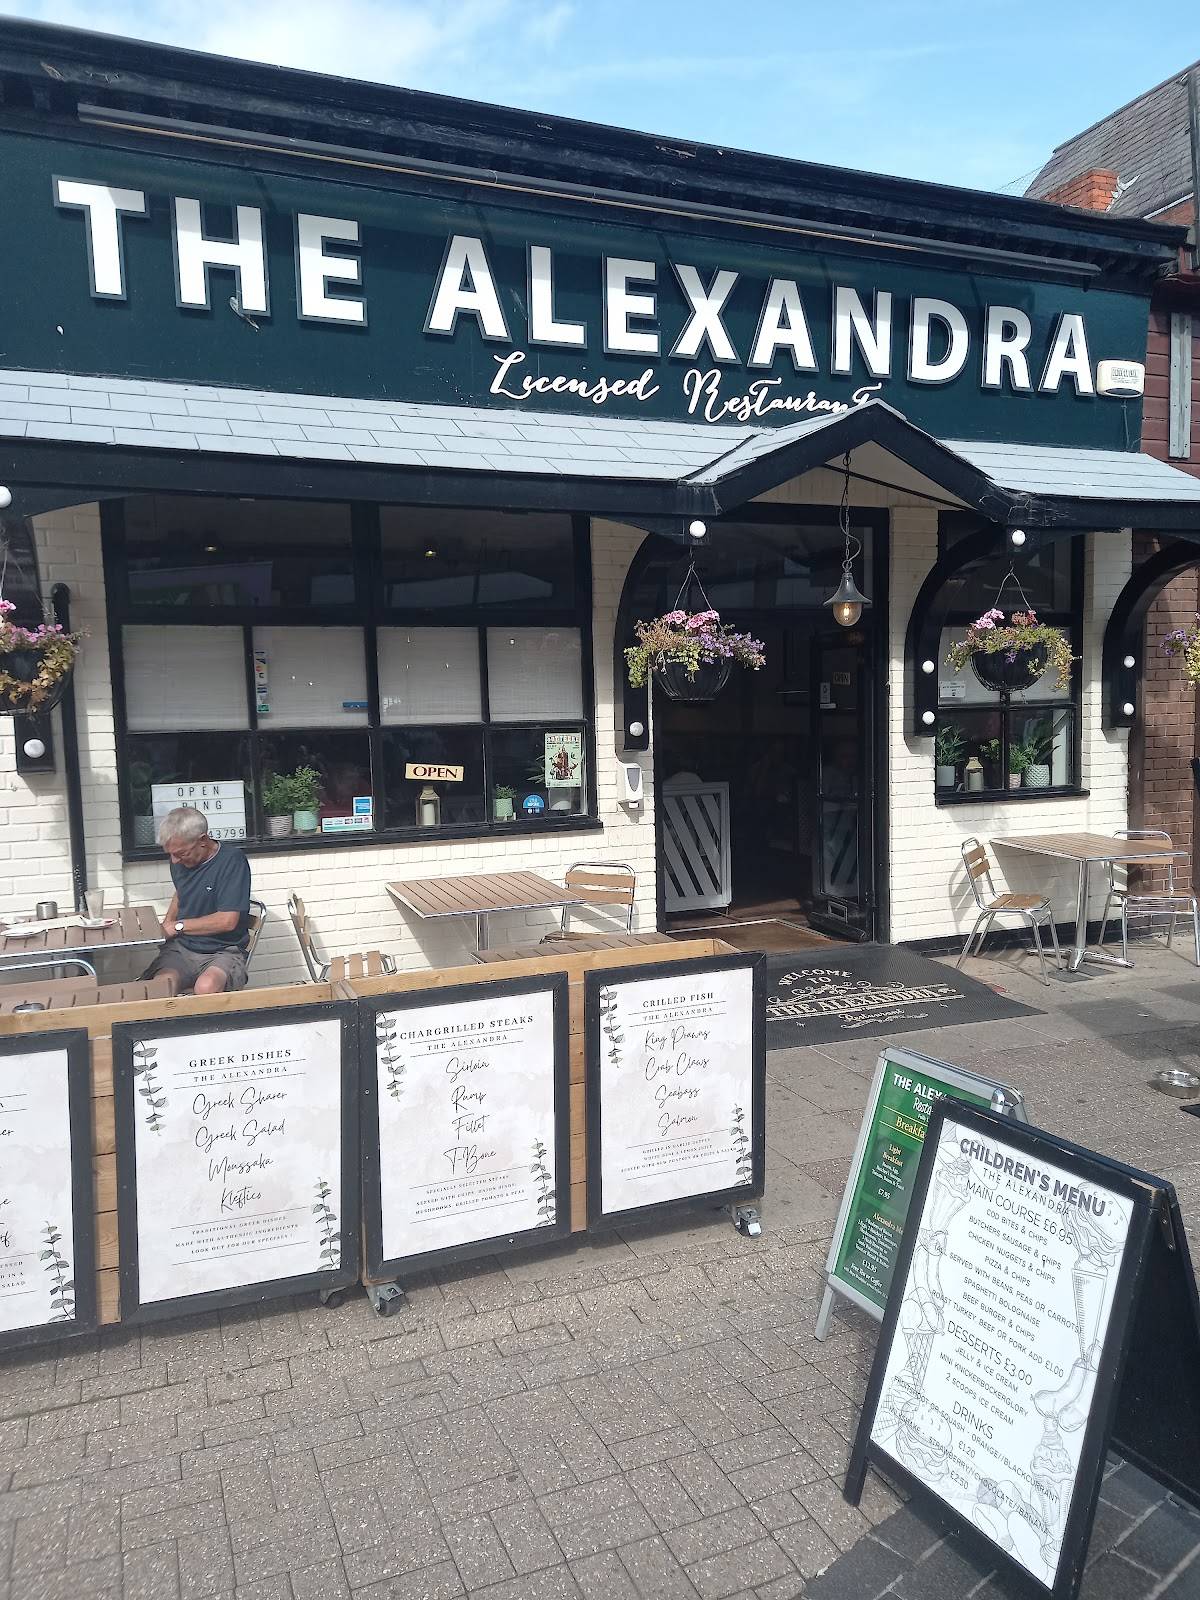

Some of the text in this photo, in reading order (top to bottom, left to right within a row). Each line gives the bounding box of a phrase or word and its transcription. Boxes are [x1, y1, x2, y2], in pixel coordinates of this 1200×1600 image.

[53, 175, 1096, 396] THE ALEXANDRA
[490, 351, 660, 404] Licensed
[413, 765, 458, 779] OPEN
[177, 785, 219, 797] OPEN
[778, 968, 853, 986] WELCOME
[807, 976, 832, 985] TO
[690, 992, 714, 1002] FISH
[767, 988, 942, 1017] THE ALEXANDRA
[400, 1015, 534, 1040] CHARGRILLED STEAKS
[642, 1007, 713, 1022] THE ALEXANDRA
[427, 1034, 508, 1051] THE ALEXANDRA
[645, 1025, 710, 1053] King Prawns
[189, 1049, 292, 1068] GREEK DISHES
[445, 1057, 490, 1084] Sirloin
[645, 1052, 710, 1081] Crab Claws
[194, 1066, 288, 1083] THE ALEXANDRA
[894, 1072, 913, 1092] THE
[193, 1086, 288, 1121] Greek Sharer
[451, 1085, 487, 1114] Rump
[655, 1085, 701, 1109] Seabass
[195, 1118, 286, 1153] Greek Salad
[452, 1113, 490, 1141] Fillet
[658, 1112, 698, 1137] Salmon
[889, 1143, 902, 1156] Light
[208, 1153, 274, 1183] Moussaka
[960, 1138, 1051, 1192] CHILDREN'S
[1053, 1179, 1106, 1217] MENU
[982, 1167, 1002, 1185] THE
[966, 1179, 1074, 1246] MAIN COURSE £6.95
[986, 1208, 1048, 1246] COD BITES & CHIPS
[968, 1215, 1062, 1271] BUTCHERS SAUSAGE & CHIPS
[967, 1230, 1056, 1285] CHICKEN NUGGETS & CHIPS
[985, 1255, 1031, 1287] PIZZA & CHIPS
[949, 1252, 973, 1270] SERVED
[974, 1265, 991, 1281] WITH
[1015, 1290, 1034, 1306] PEAS
[1034, 1301, 1046, 1313] OR
[1047, 1309, 1081, 1335] CARROTS
[963, 1276, 1041, 1328] SPAGHETTI BOLOGNAISE
[931, 1289, 952, 1305] ROAST
[978, 1318, 996, 1333] BEEF
[997, 1329, 1007, 1341] OR
[1008, 1337, 1027, 1353] PORK
[1028, 1350, 1043, 1364] ADD
[962, 1291, 1036, 1342] BEEF BURGER & CHIPS
[940, 1352, 953, 1365] MINI
[947, 1320, 1033, 1386] DESSERTS £3.00
[955, 1347, 1019, 1393] JELLY & ICE CREAM
[945, 1372, 1014, 1426] 2 SCOOPS ICE CREAM
[940, 1409, 966, 1433] SQUASH
[952, 1400, 995, 1440] DRINKS
[957, 1440, 977, 1459] £1.20
[949, 1470, 970, 1490] £2.50
